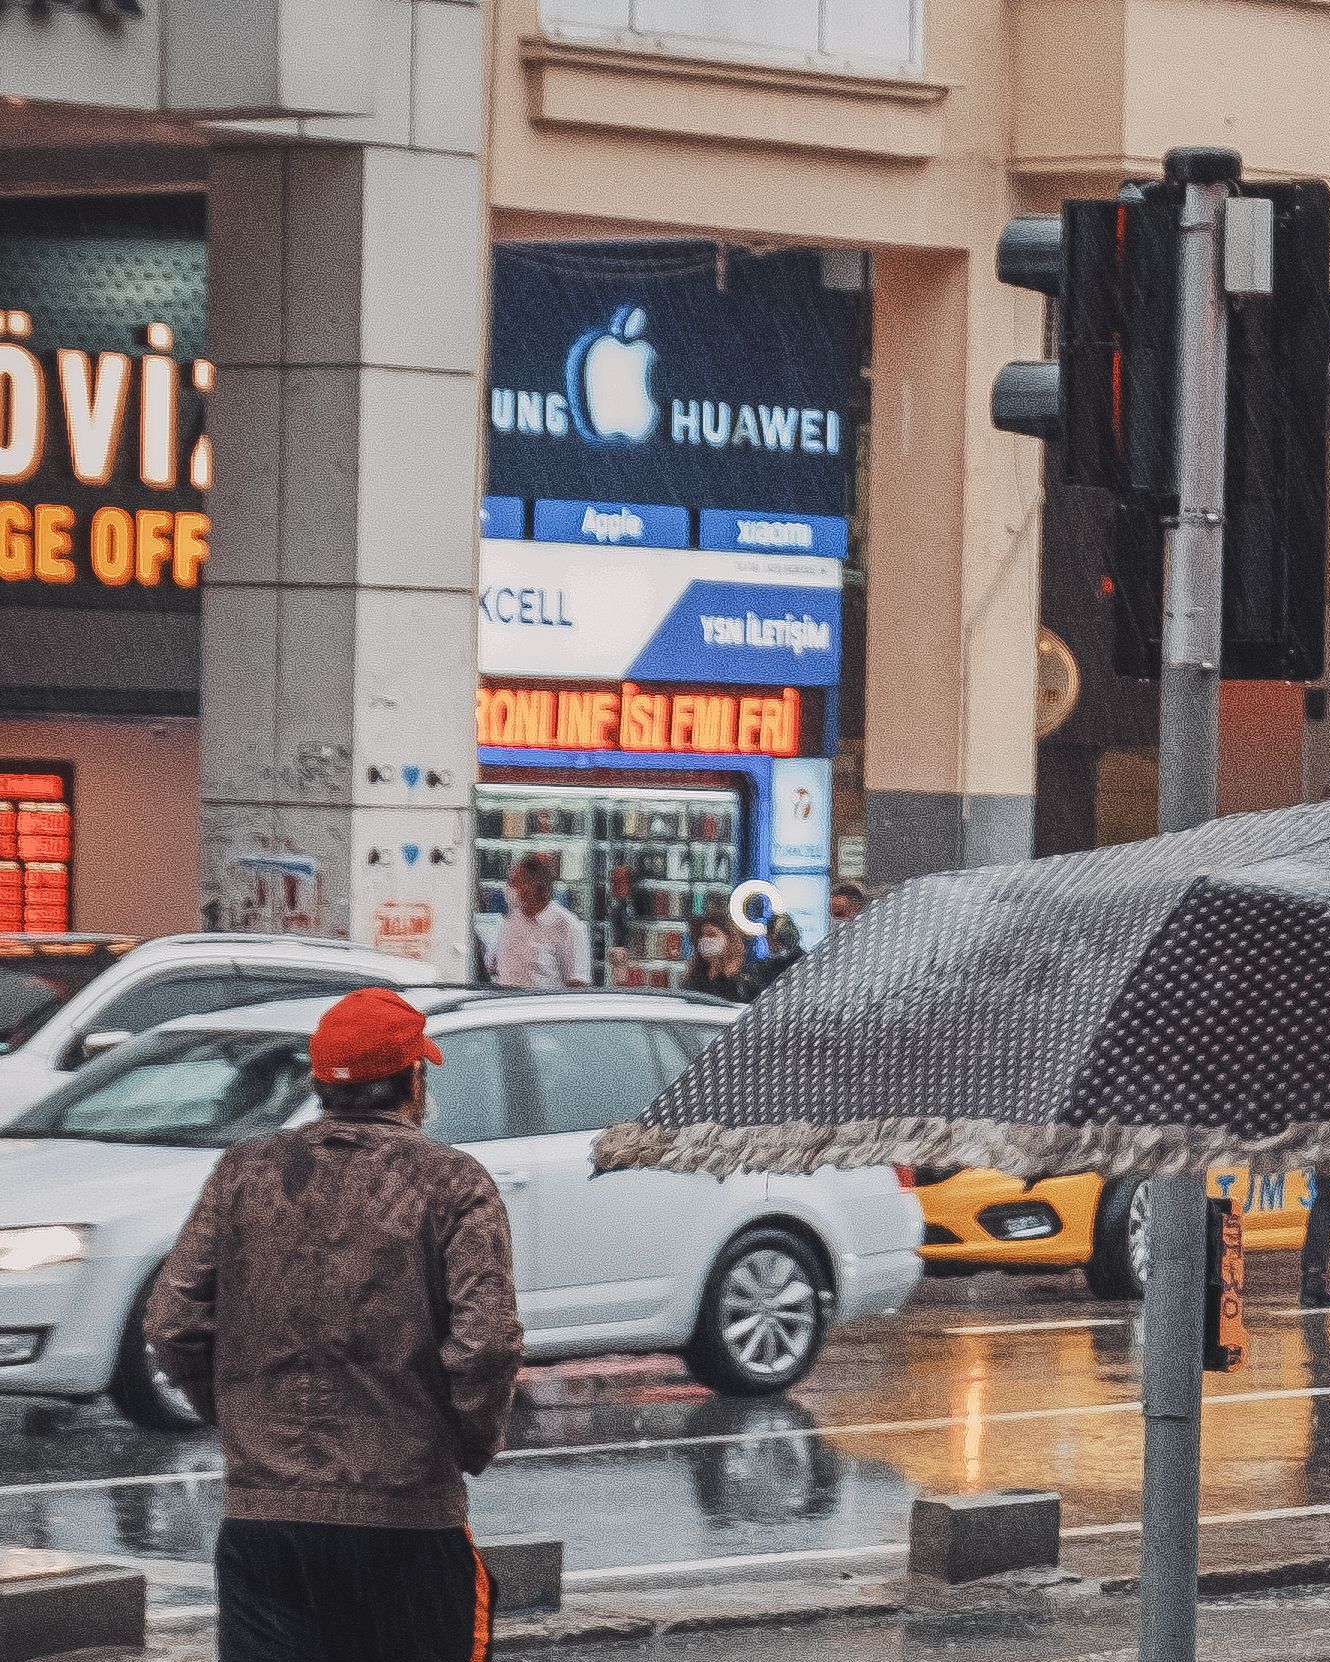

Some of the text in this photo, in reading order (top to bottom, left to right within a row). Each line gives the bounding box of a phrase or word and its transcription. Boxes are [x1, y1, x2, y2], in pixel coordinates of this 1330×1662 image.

[492, 388, 842, 455] UNG HUAWEI
[0, 501, 76, 584] GE
[582, 507, 643, 542] Apple
